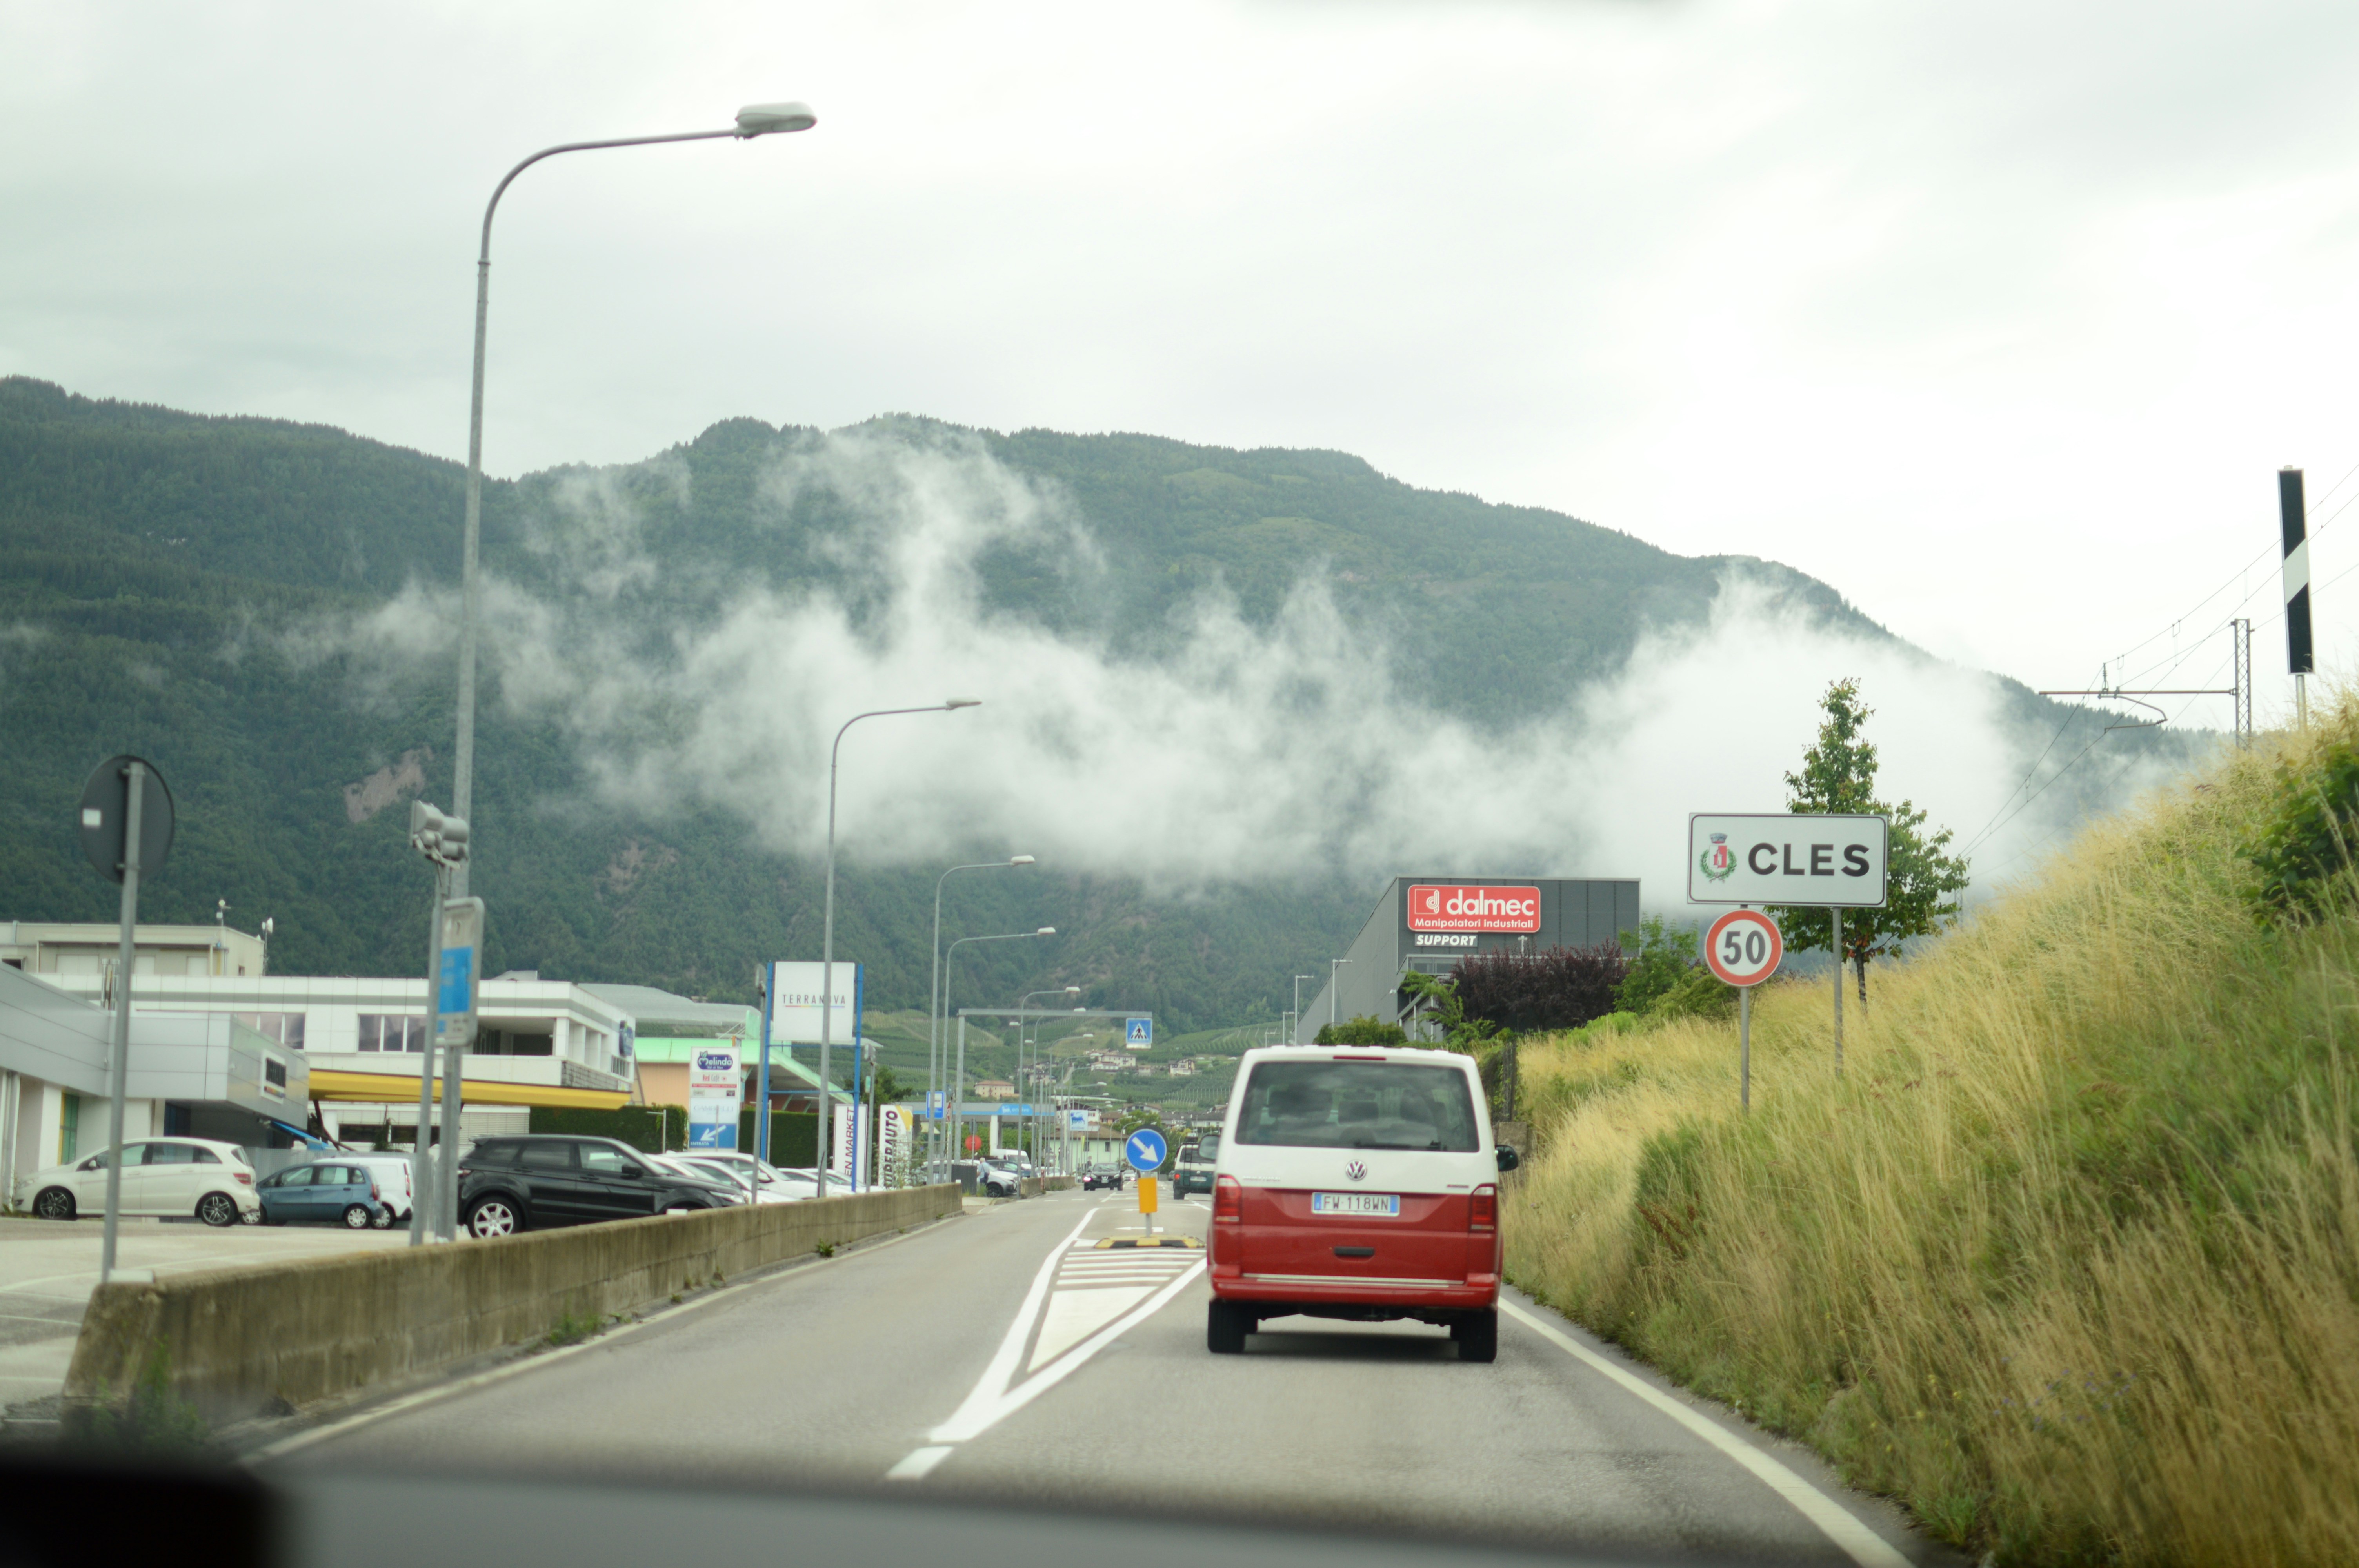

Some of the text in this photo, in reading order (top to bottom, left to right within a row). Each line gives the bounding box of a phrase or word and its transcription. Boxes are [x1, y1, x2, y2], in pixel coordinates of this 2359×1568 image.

[1748, 842, 1870, 877] CLES
[1446, 889, 1534, 916] dalmec
[1415, 918, 1533, 929] Manipolatori industriali
[1416, 935, 1476, 946] SUPPORT
[1723, 930, 1766, 965] 50
[783, 995, 845, 1004] TERRANVA
[698, 1056, 732, 1065] Melinda
